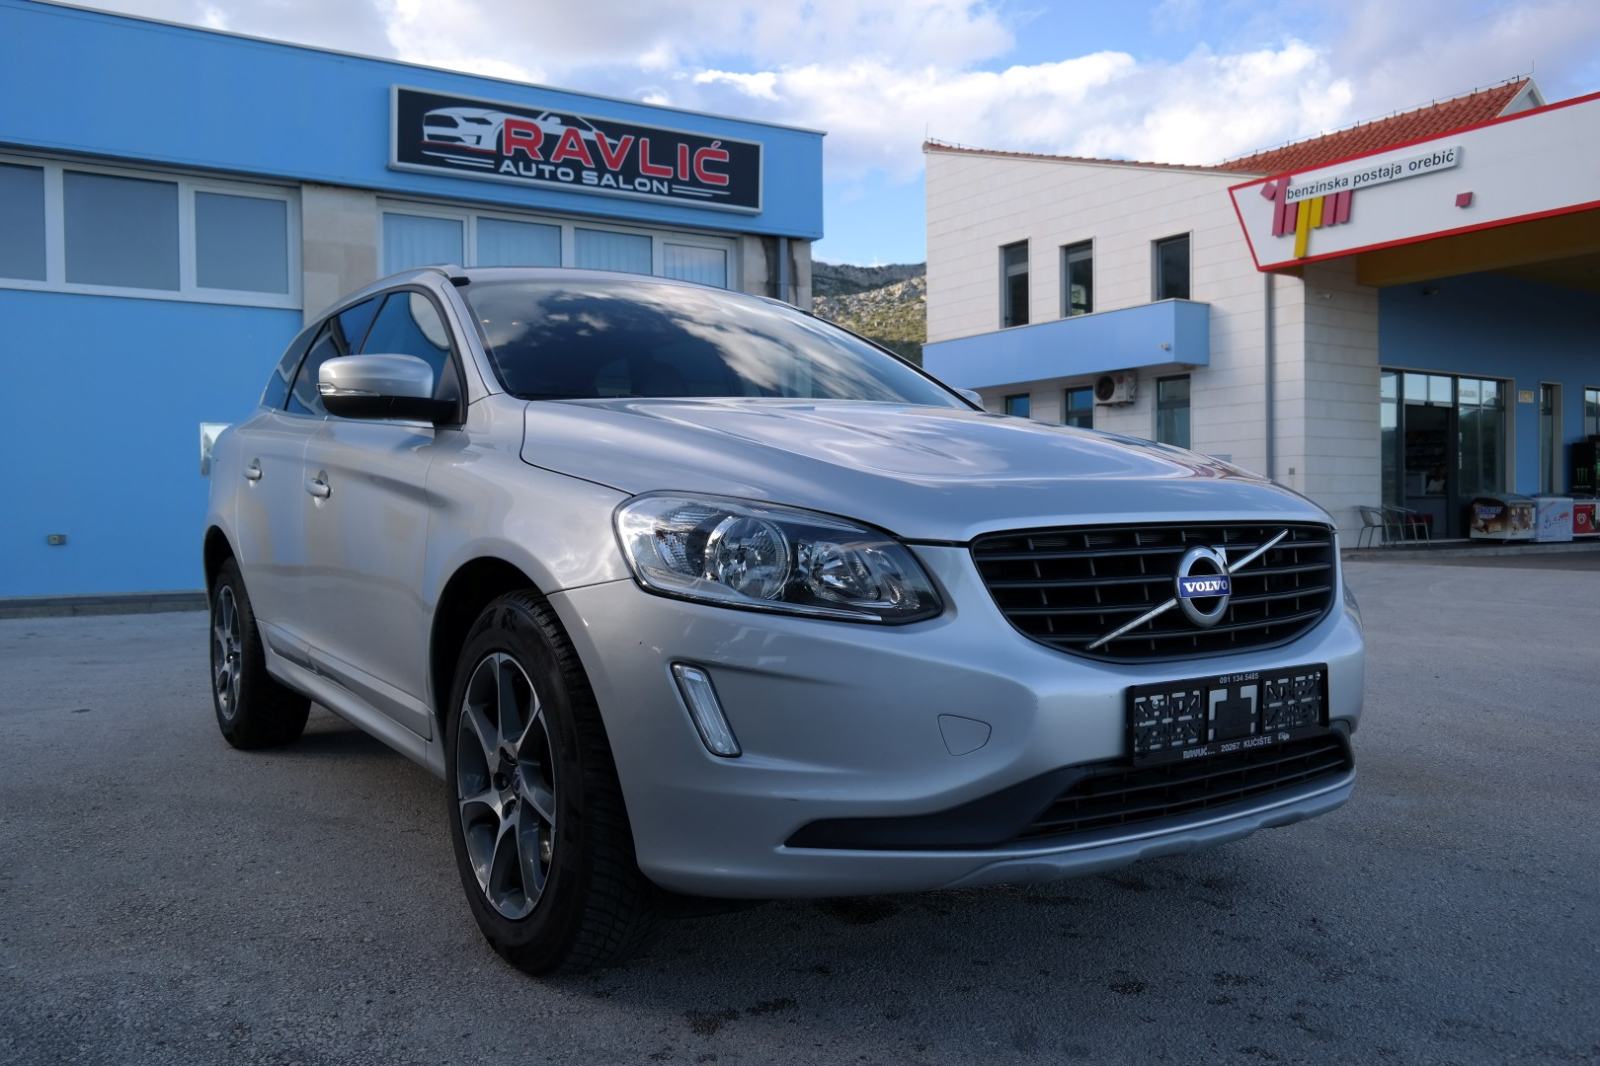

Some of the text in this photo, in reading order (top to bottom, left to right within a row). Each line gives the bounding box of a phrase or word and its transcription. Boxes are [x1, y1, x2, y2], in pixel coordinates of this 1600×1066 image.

[502, 118, 729, 186] RAVLIĆ
[499, 159, 669, 194] AUTO SALON
[1286, 149, 1455, 200] benzinska postaja orebić
[1183, 580, 1228, 592] VOLVO
